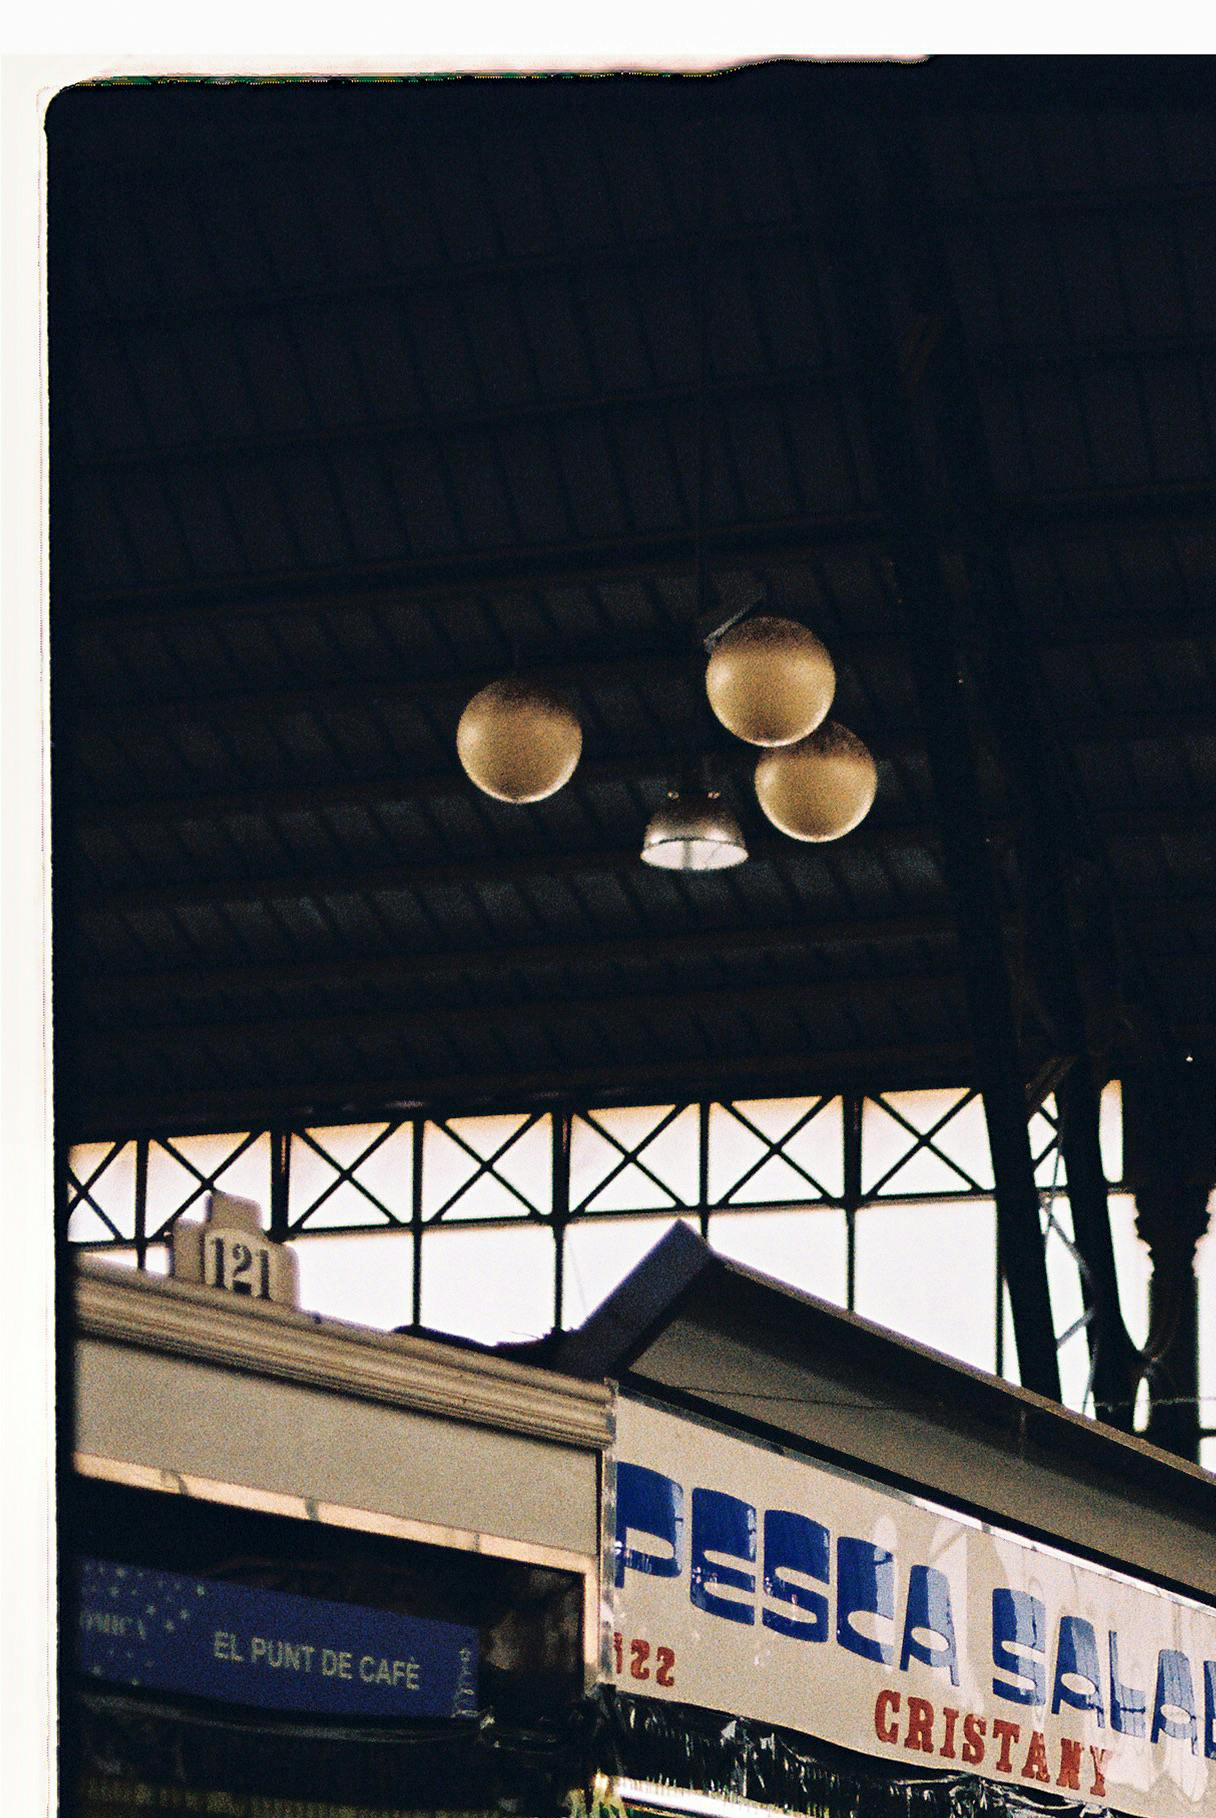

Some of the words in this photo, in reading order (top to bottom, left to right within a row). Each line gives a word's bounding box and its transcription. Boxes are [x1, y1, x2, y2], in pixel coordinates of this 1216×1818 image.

[212, 1237, 273, 1301] 121
[616, 1461, 958, 1687] PESCA
[214, 1631, 243, 1663] EL
[252, 1637, 315, 1673] PUNT
[321, 1649, 353, 1681] DE
[613, 1632, 675, 1687] 122
[874, 1689, 1113, 1798] CRISTANY
